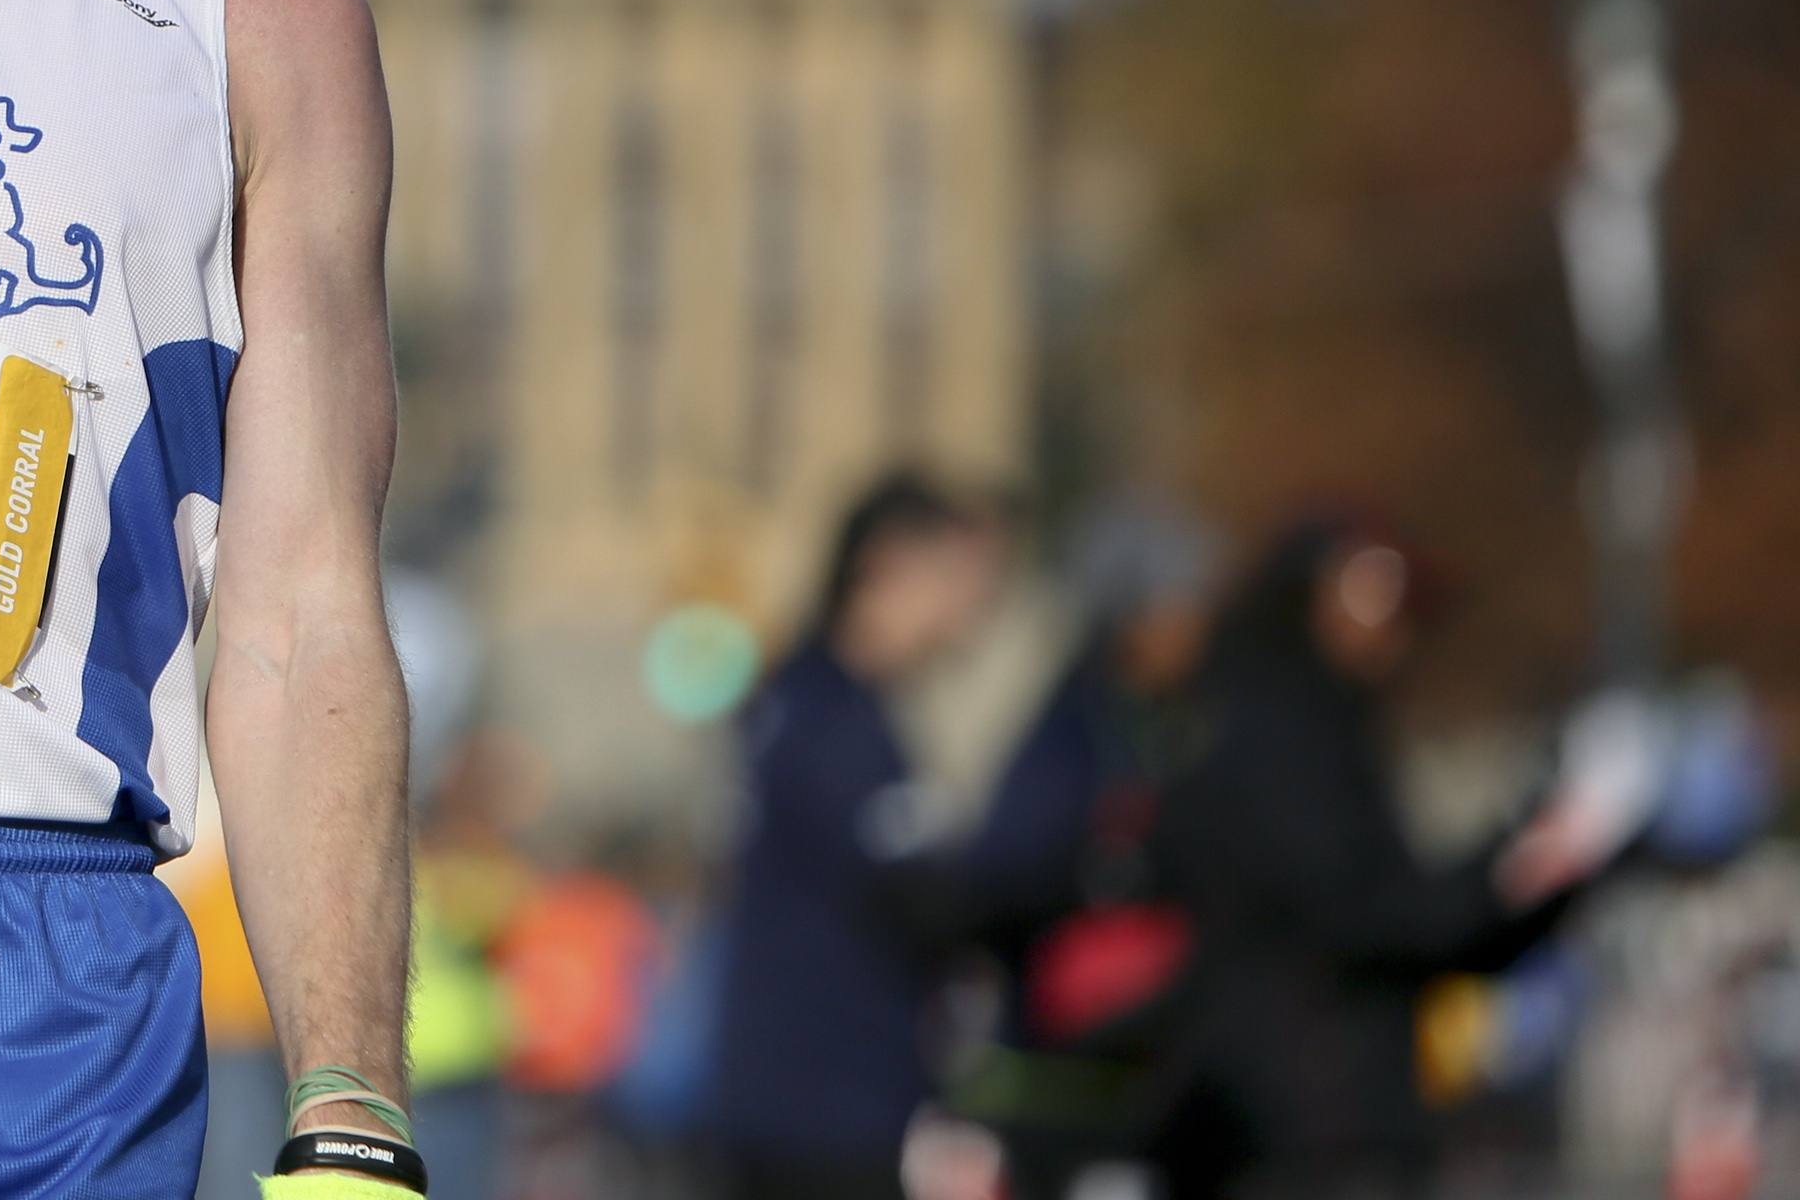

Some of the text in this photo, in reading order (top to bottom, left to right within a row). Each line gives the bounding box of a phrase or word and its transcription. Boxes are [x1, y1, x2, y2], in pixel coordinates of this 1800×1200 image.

[5, 428, 45, 534] CORRAL
[315, 1141, 395, 1164] TRUE POWER
